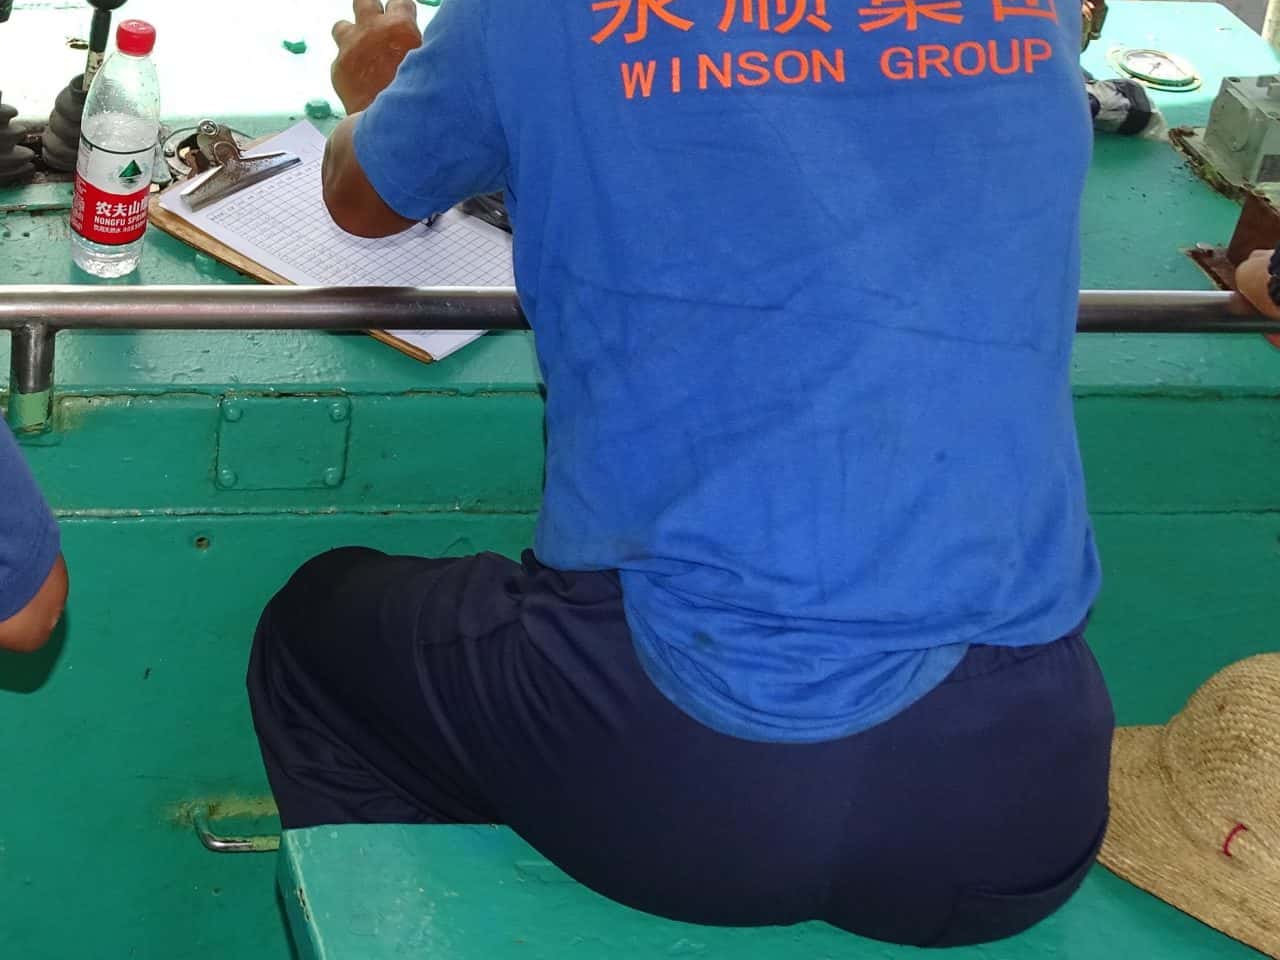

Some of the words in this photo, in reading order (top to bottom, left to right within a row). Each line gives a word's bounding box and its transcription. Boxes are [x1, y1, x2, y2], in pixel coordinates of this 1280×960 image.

[621, 49, 846, 99] WINSON
[880, 37, 1053, 80] GROUP
[93, 215, 126, 227] NONGFU
